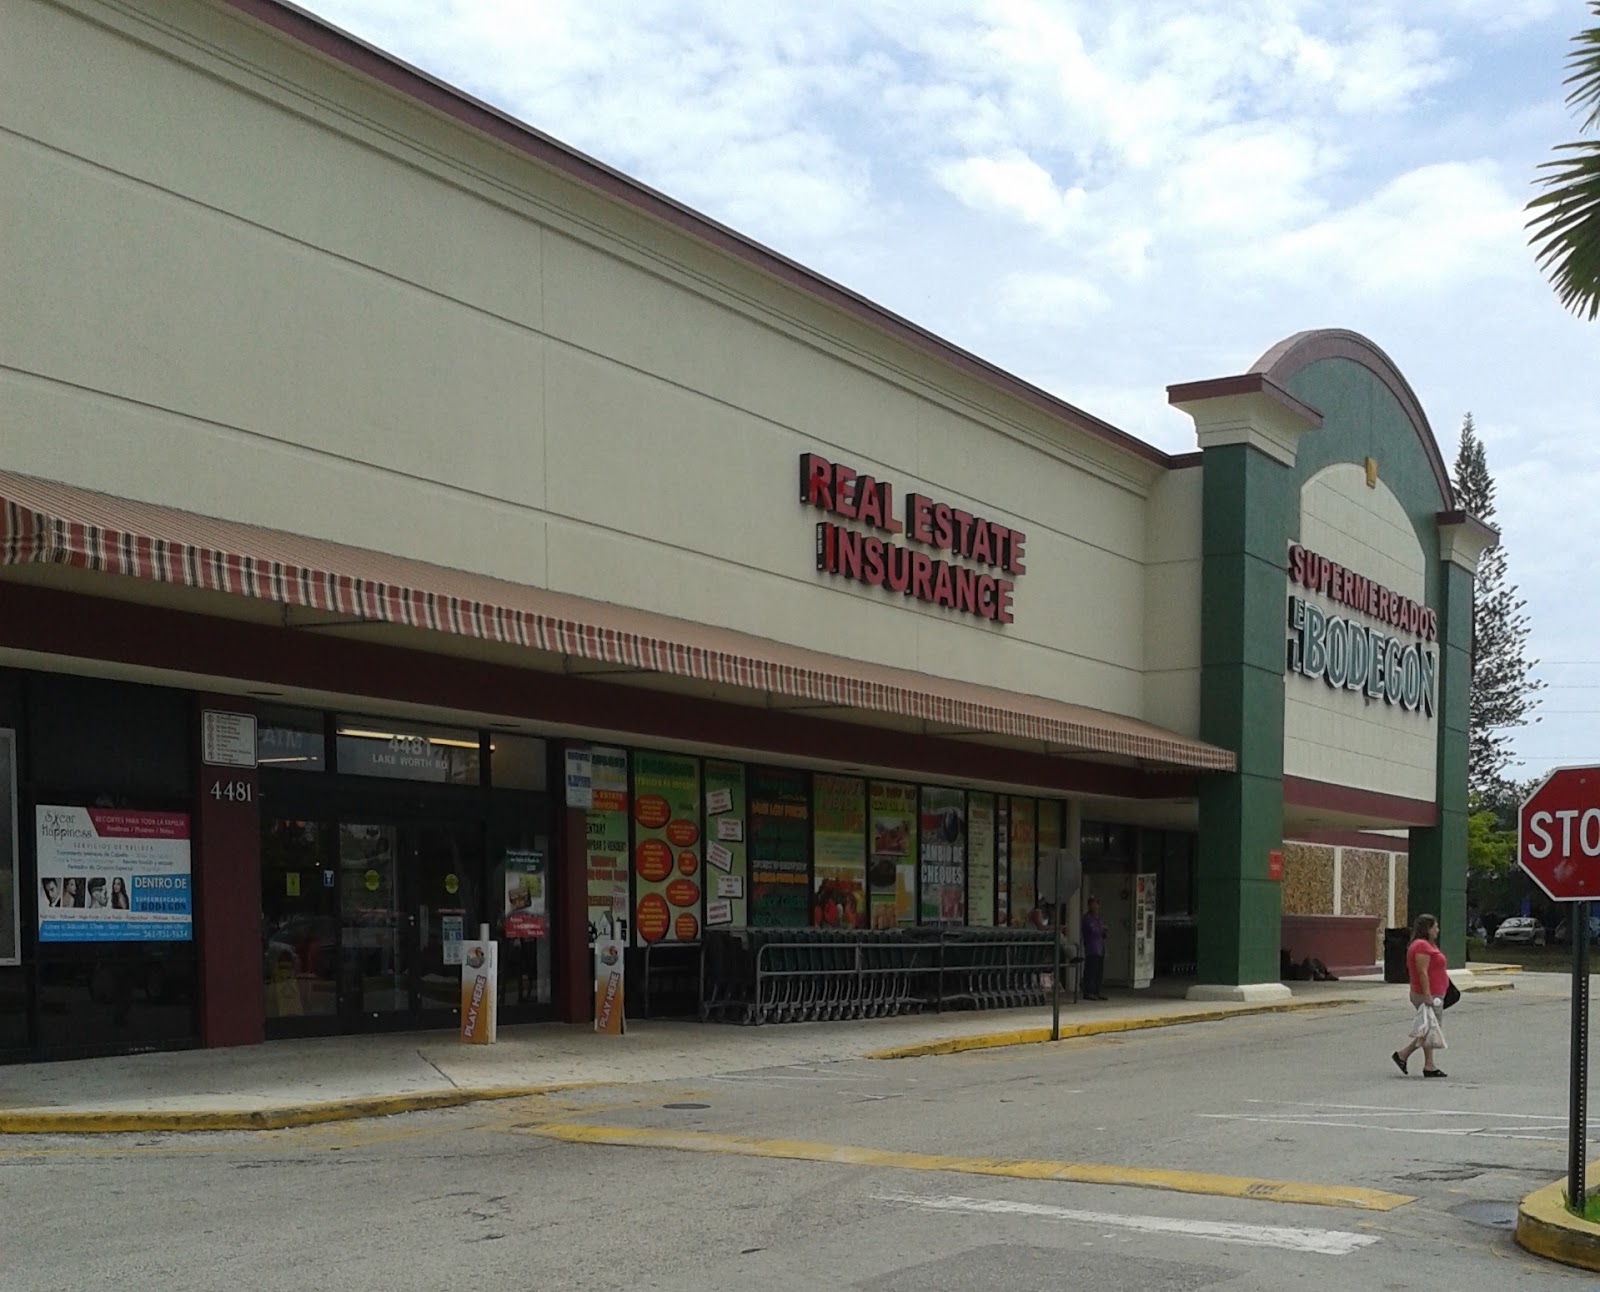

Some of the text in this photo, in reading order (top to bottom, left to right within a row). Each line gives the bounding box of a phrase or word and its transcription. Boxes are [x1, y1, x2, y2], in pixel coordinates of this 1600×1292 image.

[800, 453, 1026, 575] REAL ESTATE
[816, 522, 1014, 624] INSURANCE
[1289, 545, 1438, 642] SUPERMERCADOS
[1303, 601, 1440, 718] BODEGON
[388, 735, 432, 757] 4481
[372, 753, 396, 765] LAKE
[400, 756, 433, 768] WORTH
[210, 780, 252, 802] 4481
[1527, 808, 1600, 859] STO
[921, 843, 963, 863] CAMBIO DE
[134, 877, 187, 889] DENTRO DE
[921, 865, 963, 885] CHEQUES
[463, 974, 487, 1038] PLAY HERE
[598, 1001, 612, 1029] PLAY
